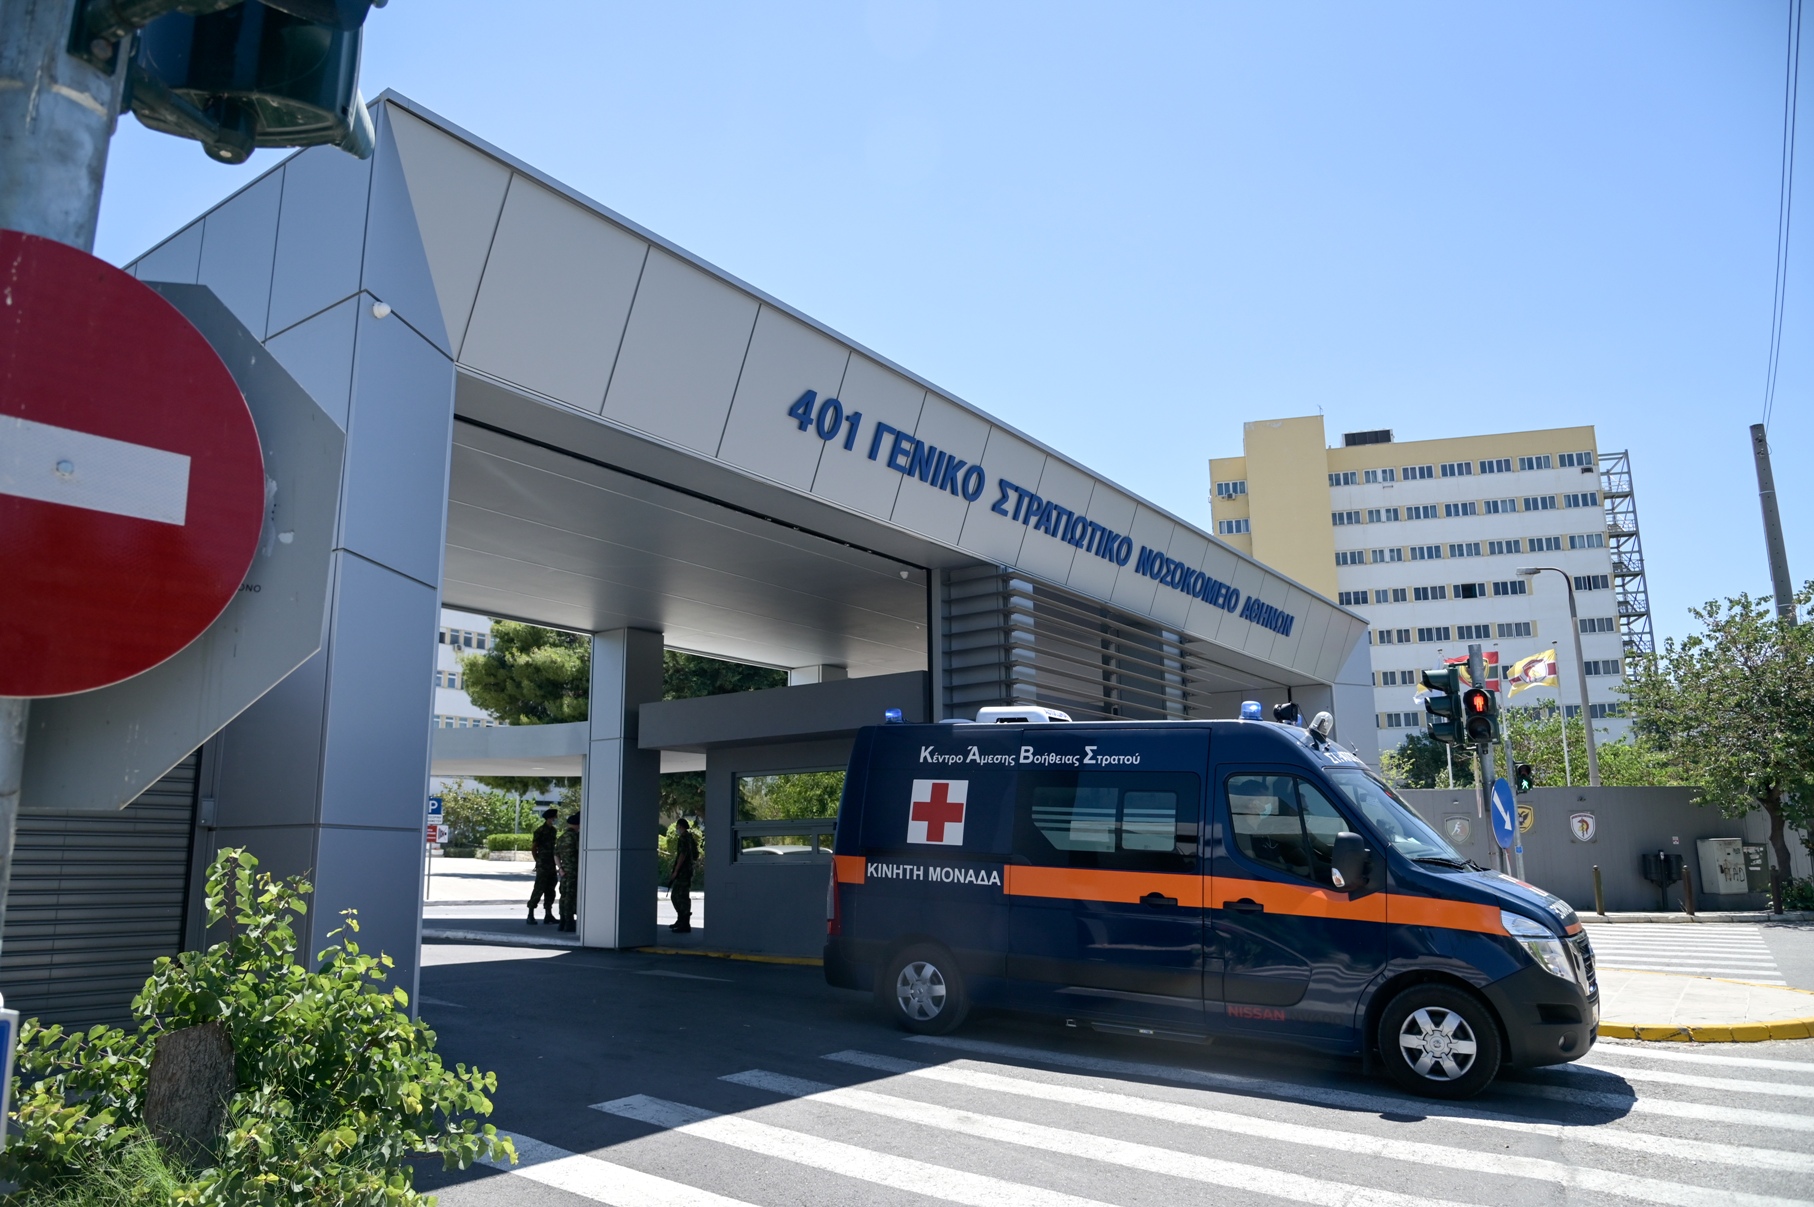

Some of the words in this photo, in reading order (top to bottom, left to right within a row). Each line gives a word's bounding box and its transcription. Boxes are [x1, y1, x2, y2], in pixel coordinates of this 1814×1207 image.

[788, 389, 863, 452] 401
[867, 421, 986, 503] ΓΕΝΙΚΟ
[991, 478, 1133, 567] ΣΤΡΑΤΙΩΤΙΚΟ
[1134, 545, 1240, 614] ΝΟΣΟΚΟΜΕΙΟ
[1240, 595, 1295, 638] ΑΘΗΝΩΝ
[919, 745, 963, 764] Κέντρο
[966, 745, 1015, 766] Άμεσης
[1019, 745, 1080, 766] Βοήθειας
[1083, 745, 1141, 765] Στρατού
[867, 862, 924, 881] ΚΙΝΗΤΗ
[928, 866, 1001, 886] ΜΟΝΑΔΑ
[1227, 1005, 1286, 1021] NISSAN
